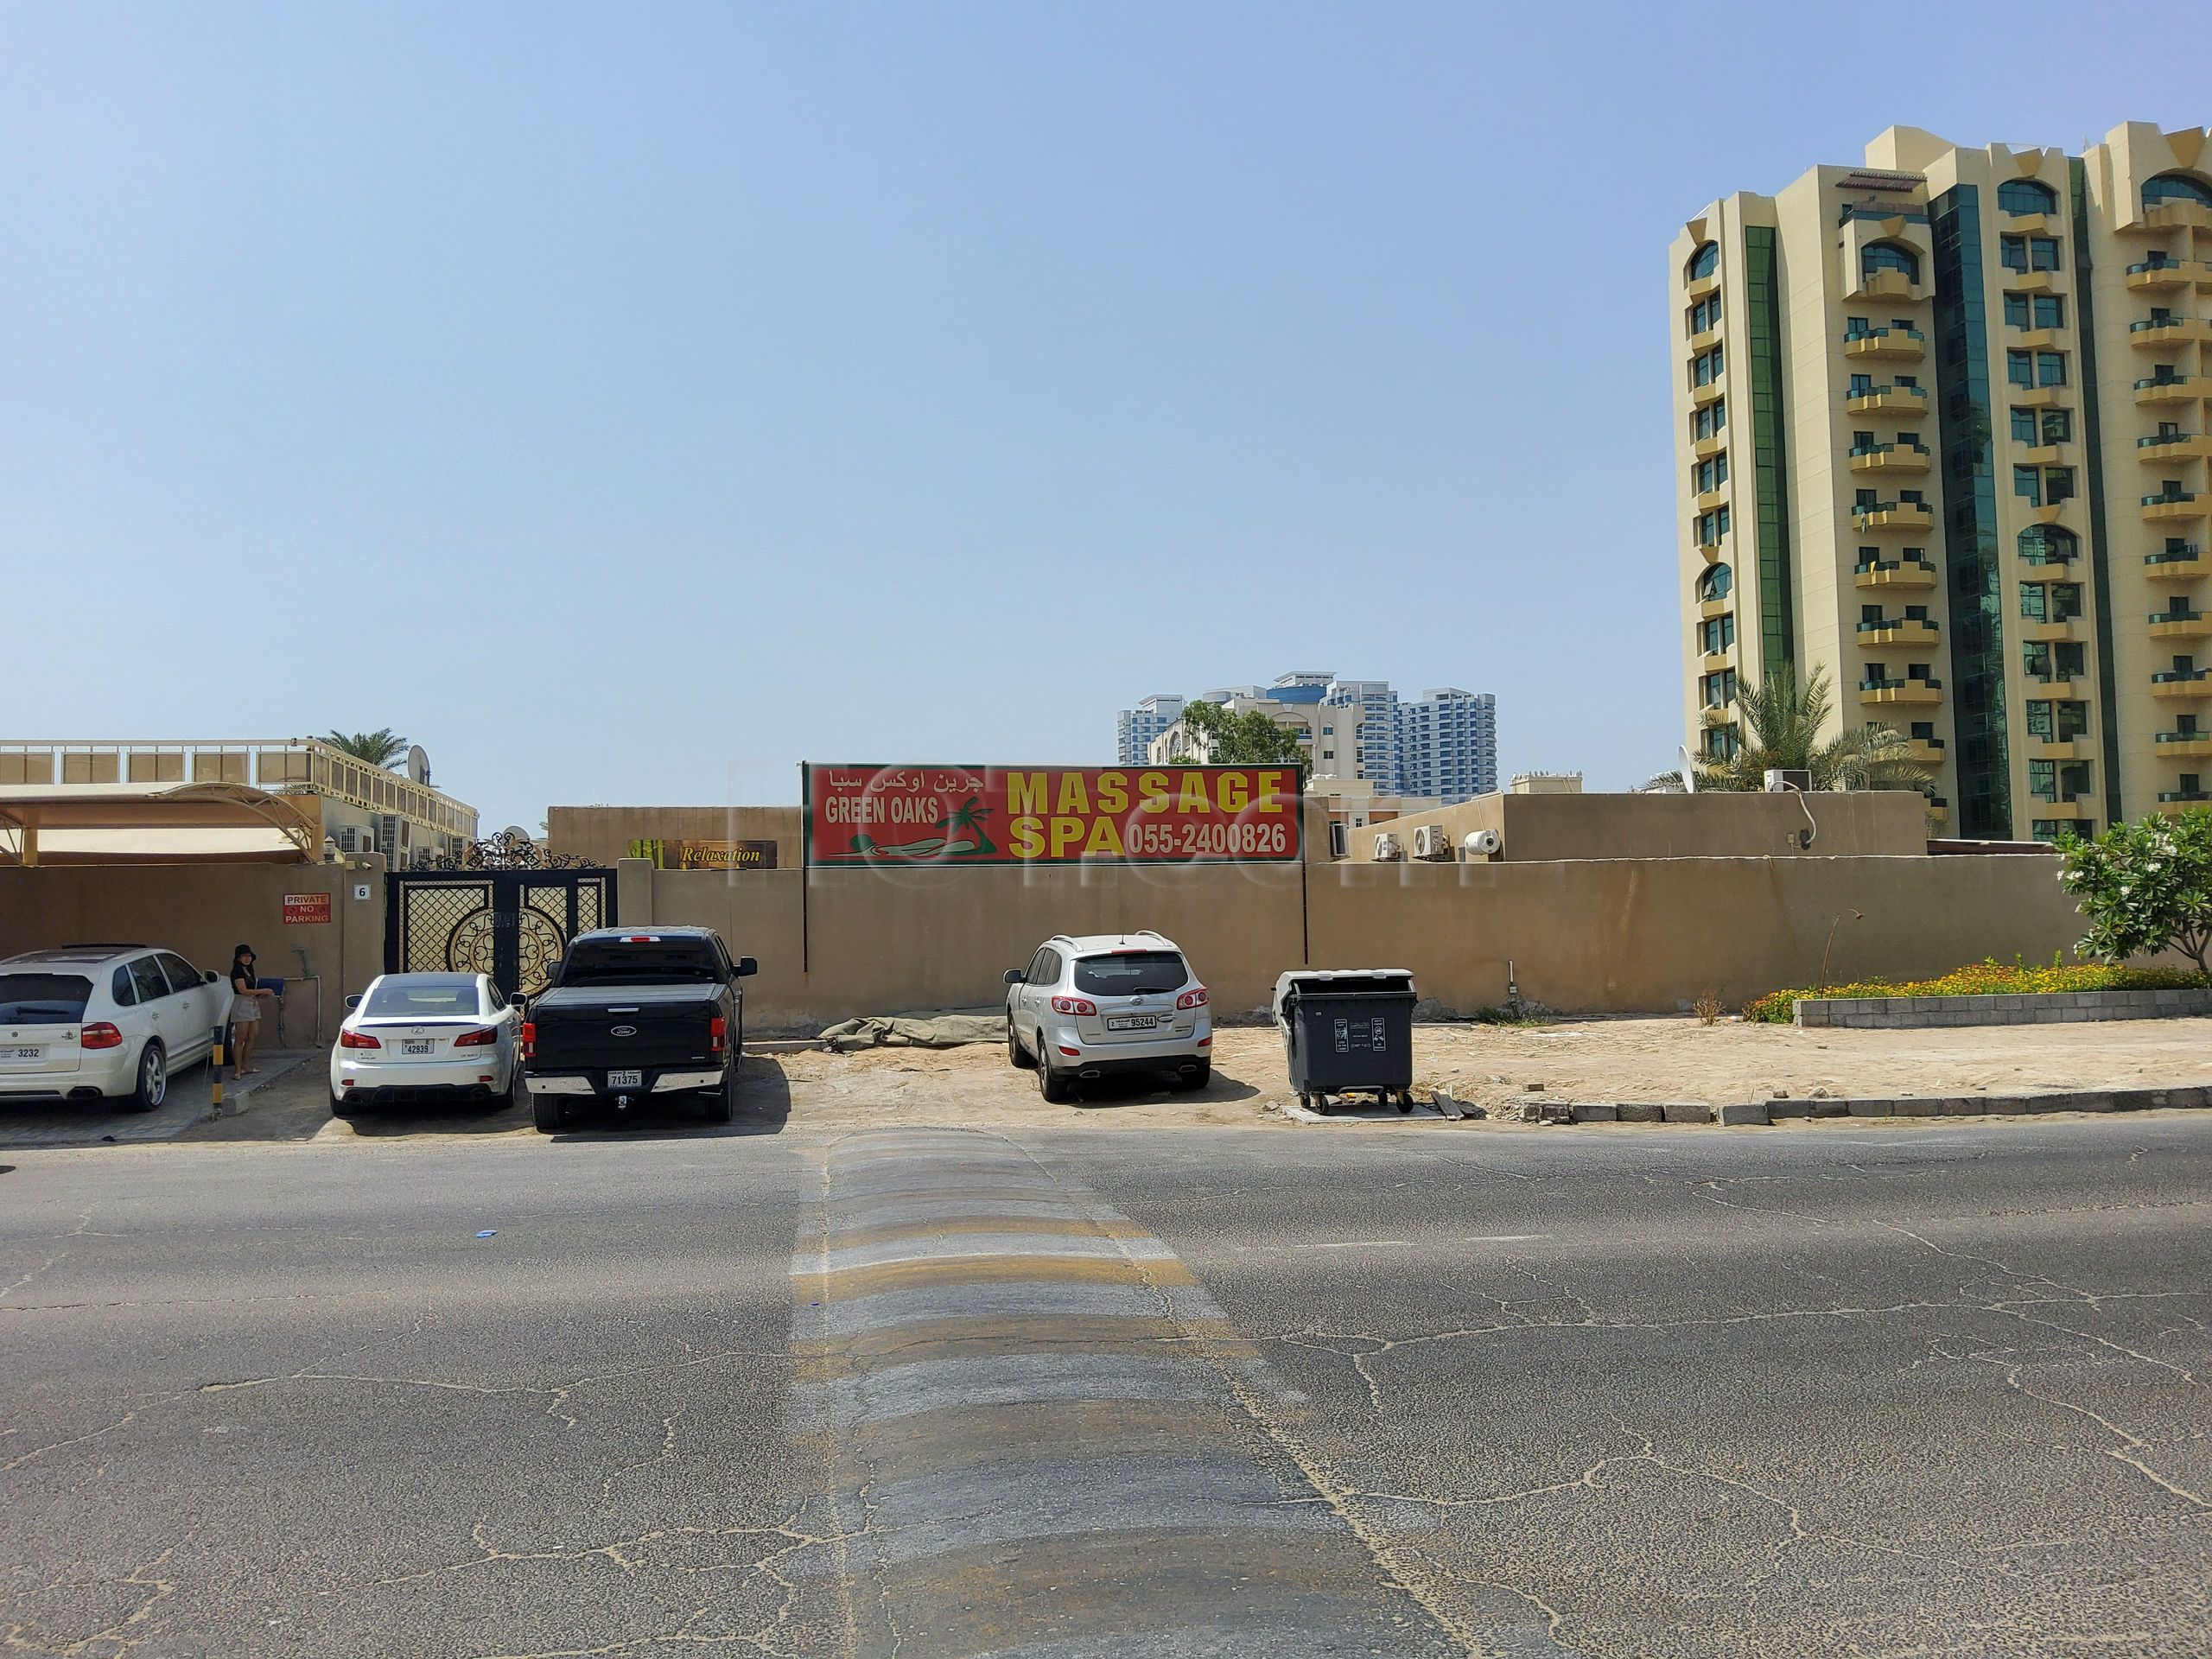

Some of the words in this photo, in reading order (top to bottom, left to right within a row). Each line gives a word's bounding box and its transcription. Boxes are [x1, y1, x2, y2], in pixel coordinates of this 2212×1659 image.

[829, 769, 862, 791] سبا
[1007, 772, 1283, 814] MASSAGE
[825, 796, 885, 823] GREEN
[890, 796, 938, 823] OAKS
[1008, 816, 1126, 858] SPA
[1128, 823, 1287, 854] 055-2400826
[681, 846, 760, 862] Relaxation
[359, 887, 365, 896] 6
[1131, 1017, 1154, 1027] 95244
[17, 1048, 40, 1058] 3232
[612, 1075, 638, 1084] 71375
